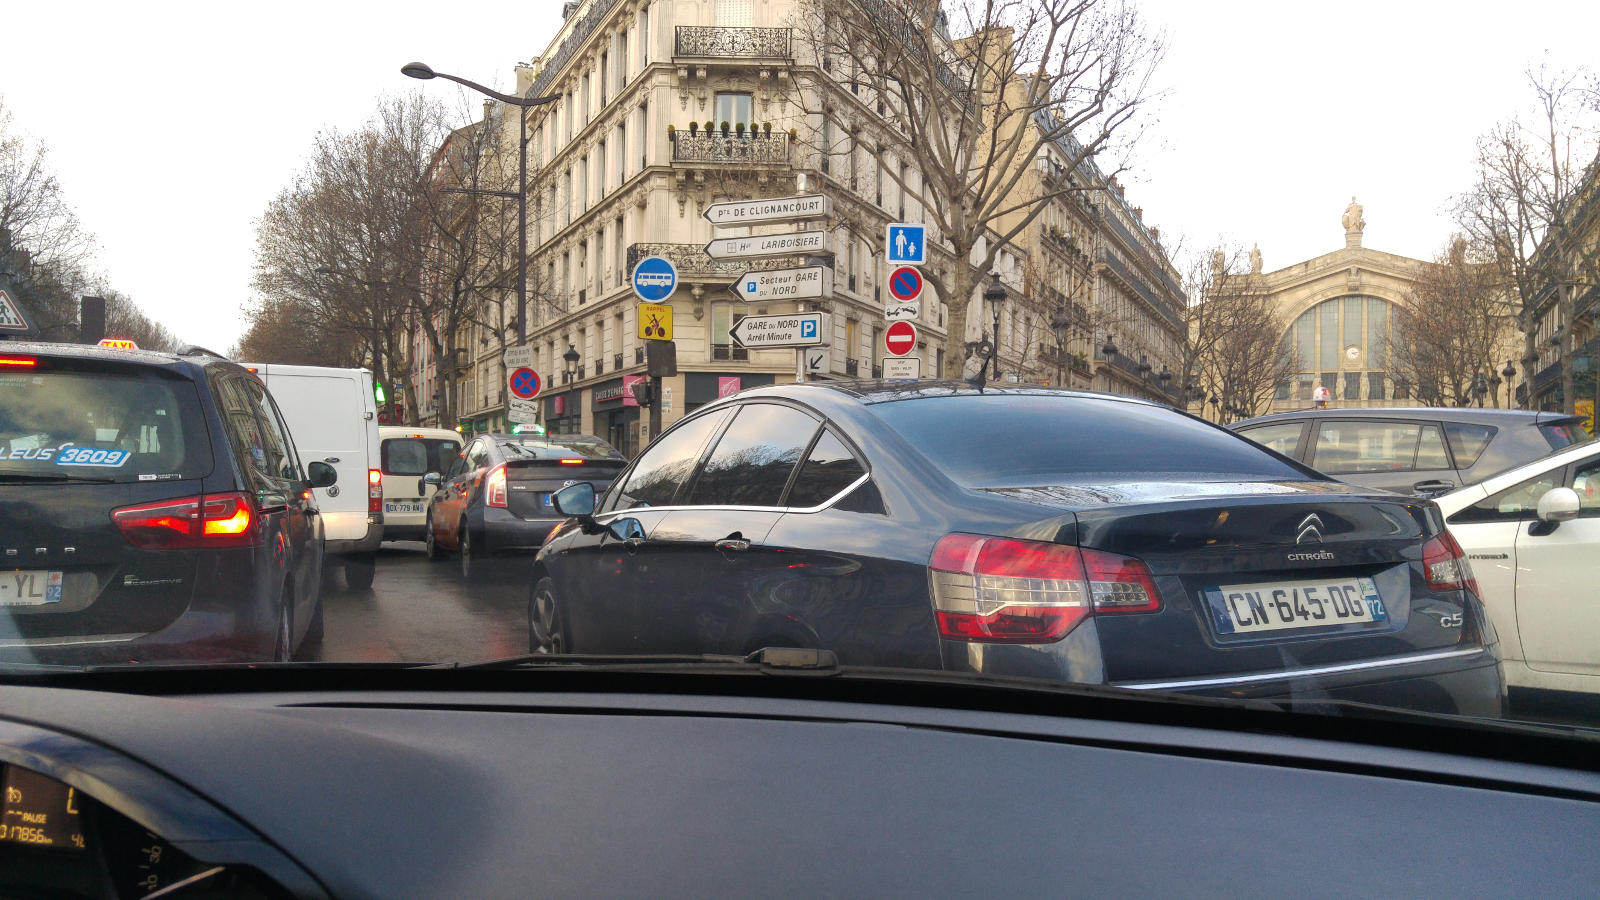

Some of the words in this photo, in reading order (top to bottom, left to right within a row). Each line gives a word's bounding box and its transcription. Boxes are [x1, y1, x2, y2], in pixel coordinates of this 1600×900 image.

[734, 208, 745, 217] DE
[749, 201, 820, 215] CLIGNANCOURT
[761, 236, 820, 250] LARIBOISIERE
[760, 276, 792, 285] Secteur
[795, 272, 819, 282] GARE
[771, 285, 797, 295] NORD
[747, 321, 768, 331] GARE
[776, 320, 799, 330] NORD
[803, 321, 815, 337] P
[766, 332, 792, 341] Minute
[60, 448, 123, 463] 3609
[47, 586, 62, 598] 92
[1228, 585, 1365, 627] CN-645-DG
[1369, 599, 1385, 616] 72
[1440, 612, 1464, 628] C5
[23, 812, 47, 824] PAUSE
